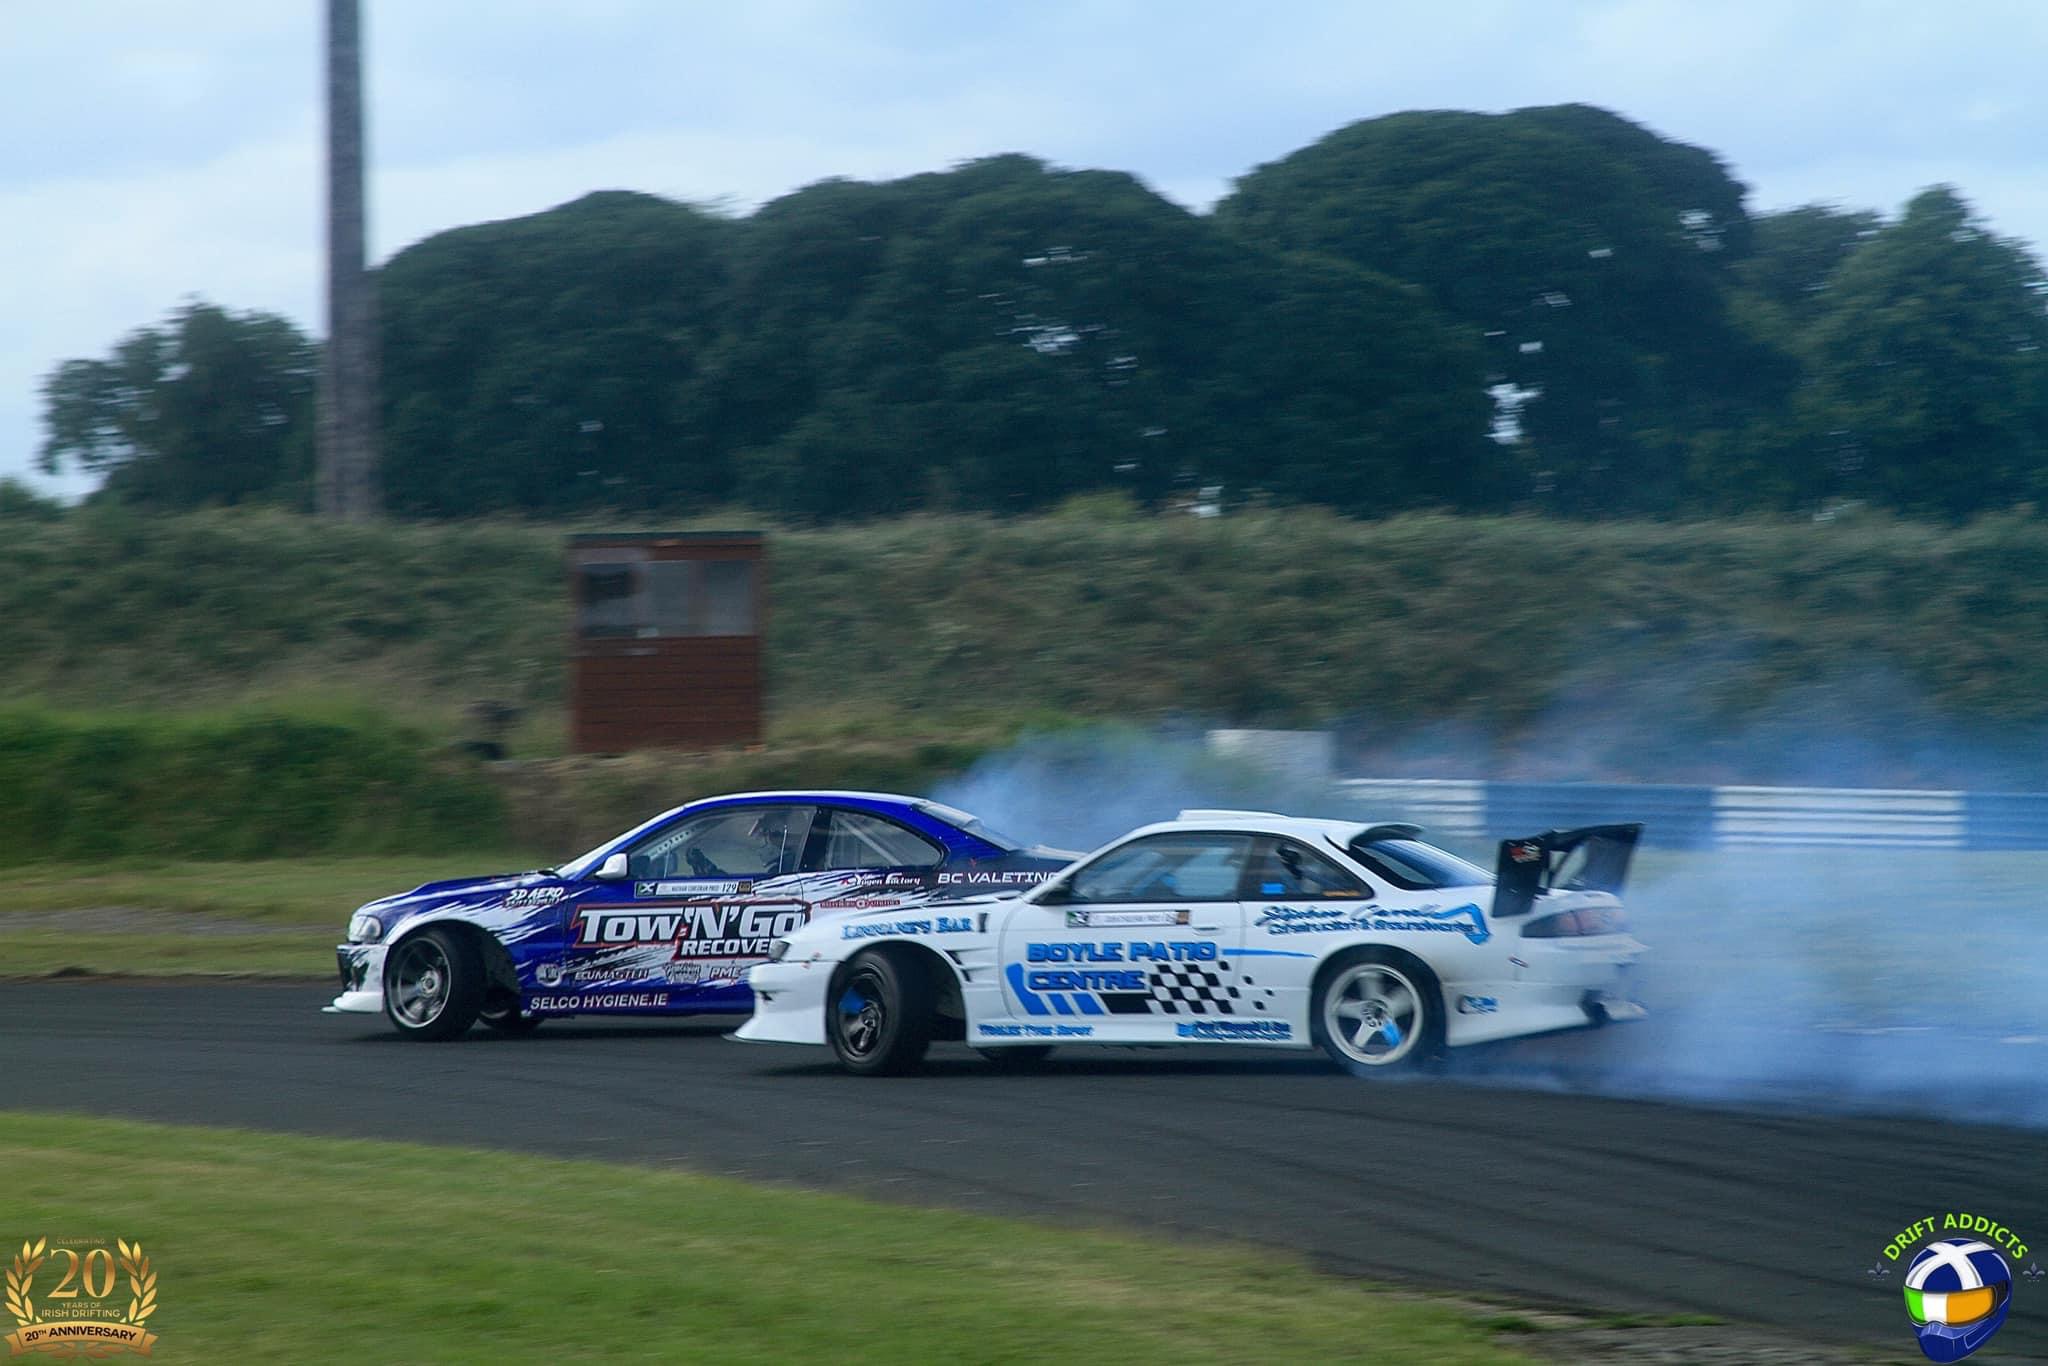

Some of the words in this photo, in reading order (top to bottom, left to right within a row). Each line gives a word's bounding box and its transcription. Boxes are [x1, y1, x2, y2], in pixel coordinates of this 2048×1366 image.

[937, 873, 963, 884] BC
[722, 883, 737, 893] 129
[1027, 942, 1124, 963] BOYLE
[1128, 942, 1218, 962] PATIO
[1028, 970, 1146, 991] CENTRE
[530, 996, 580, 1011] SELCO
[582, 993, 668, 1008] HYGIENE.IE
